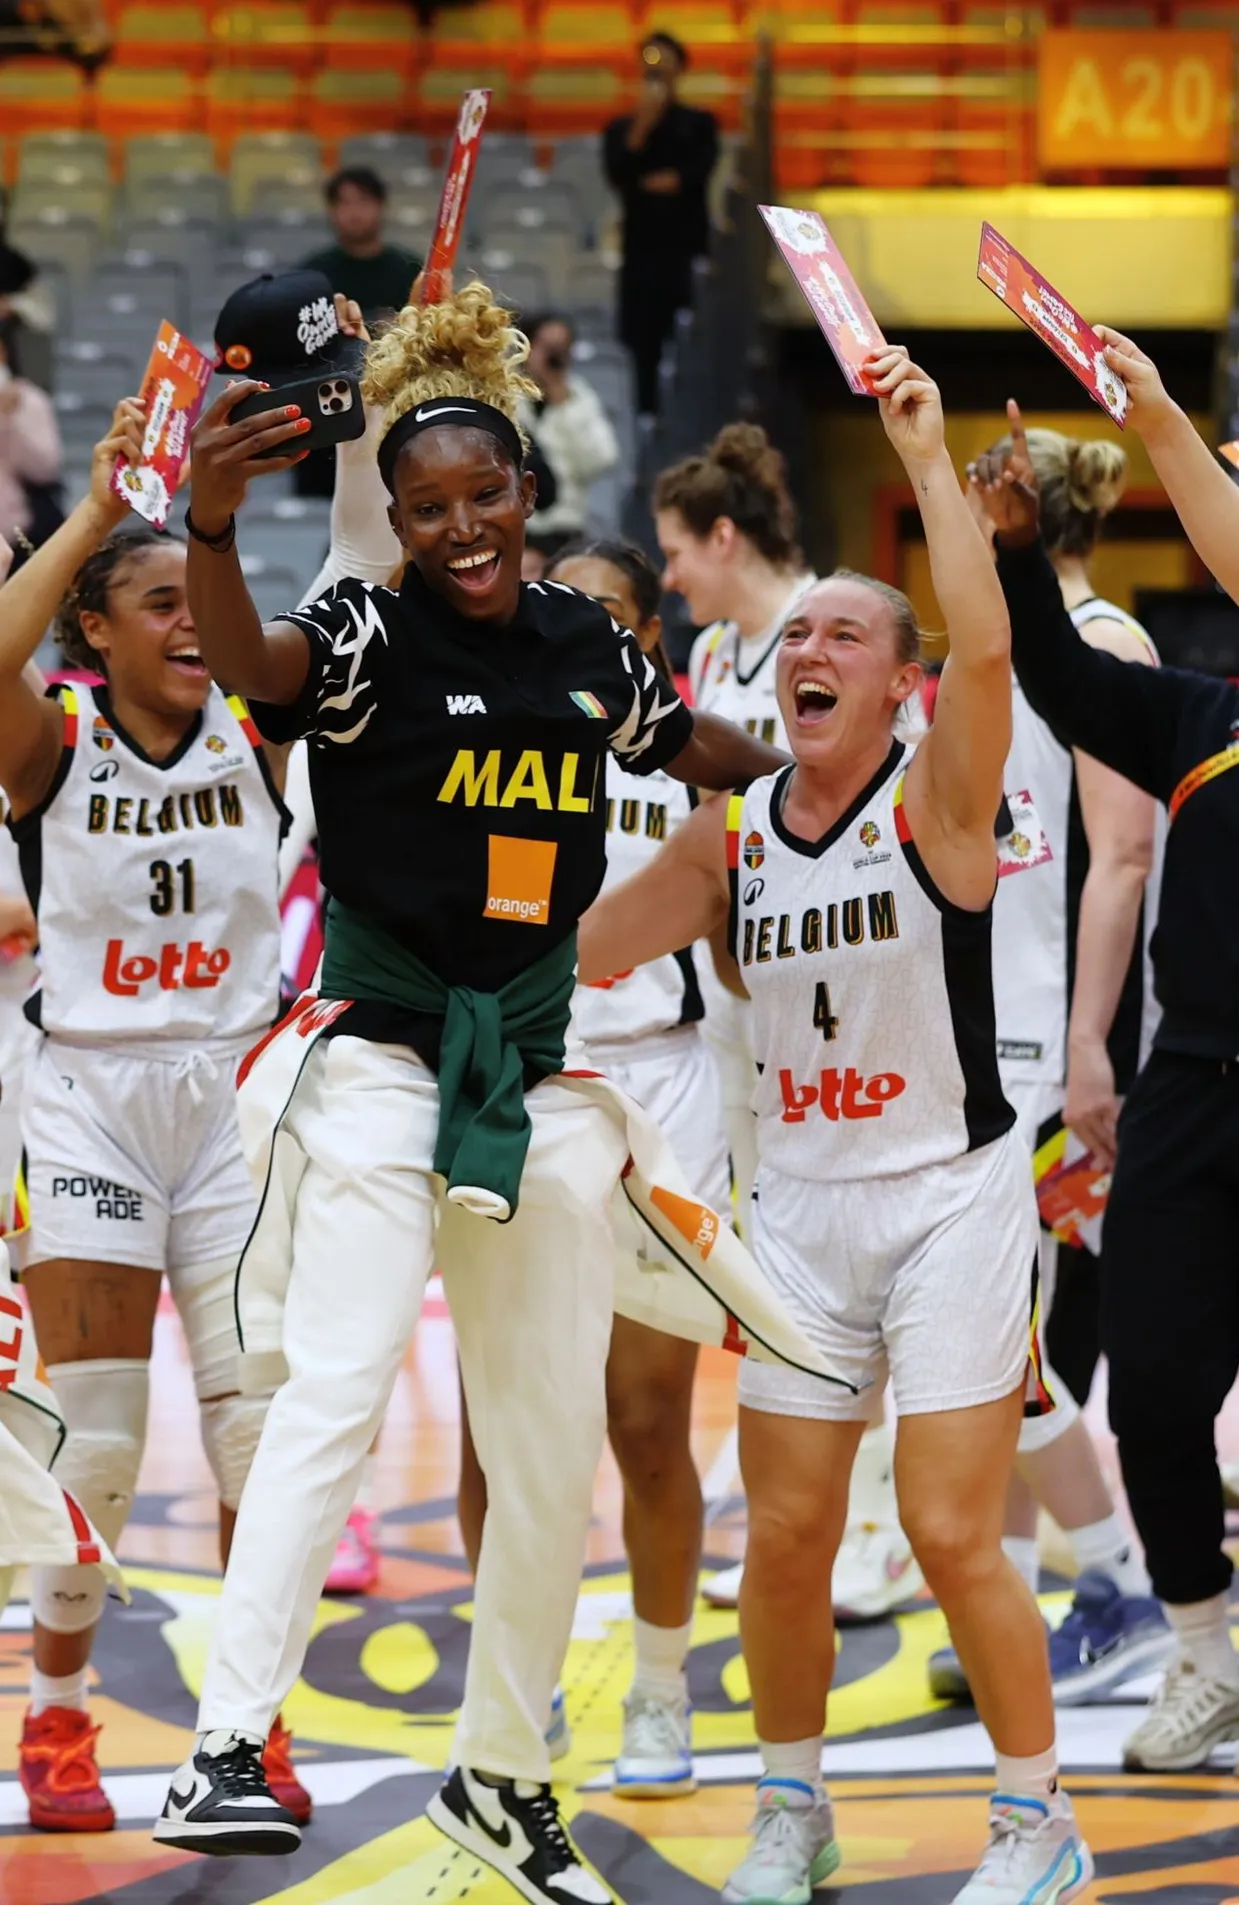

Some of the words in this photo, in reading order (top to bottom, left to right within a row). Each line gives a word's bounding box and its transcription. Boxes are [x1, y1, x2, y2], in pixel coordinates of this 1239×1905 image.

[1053, 58, 1213, 140] A20
[446, 695, 487, 715] WA
[87, 785, 243, 837] BELGIUM
[437, 749, 600, 814] MAL
[149, 859, 195, 917] 31
[743, 890, 899, 966] BELGIUM
[813, 981, 839, 1042] 4
[96, 1199, 144, 1221] ADE
